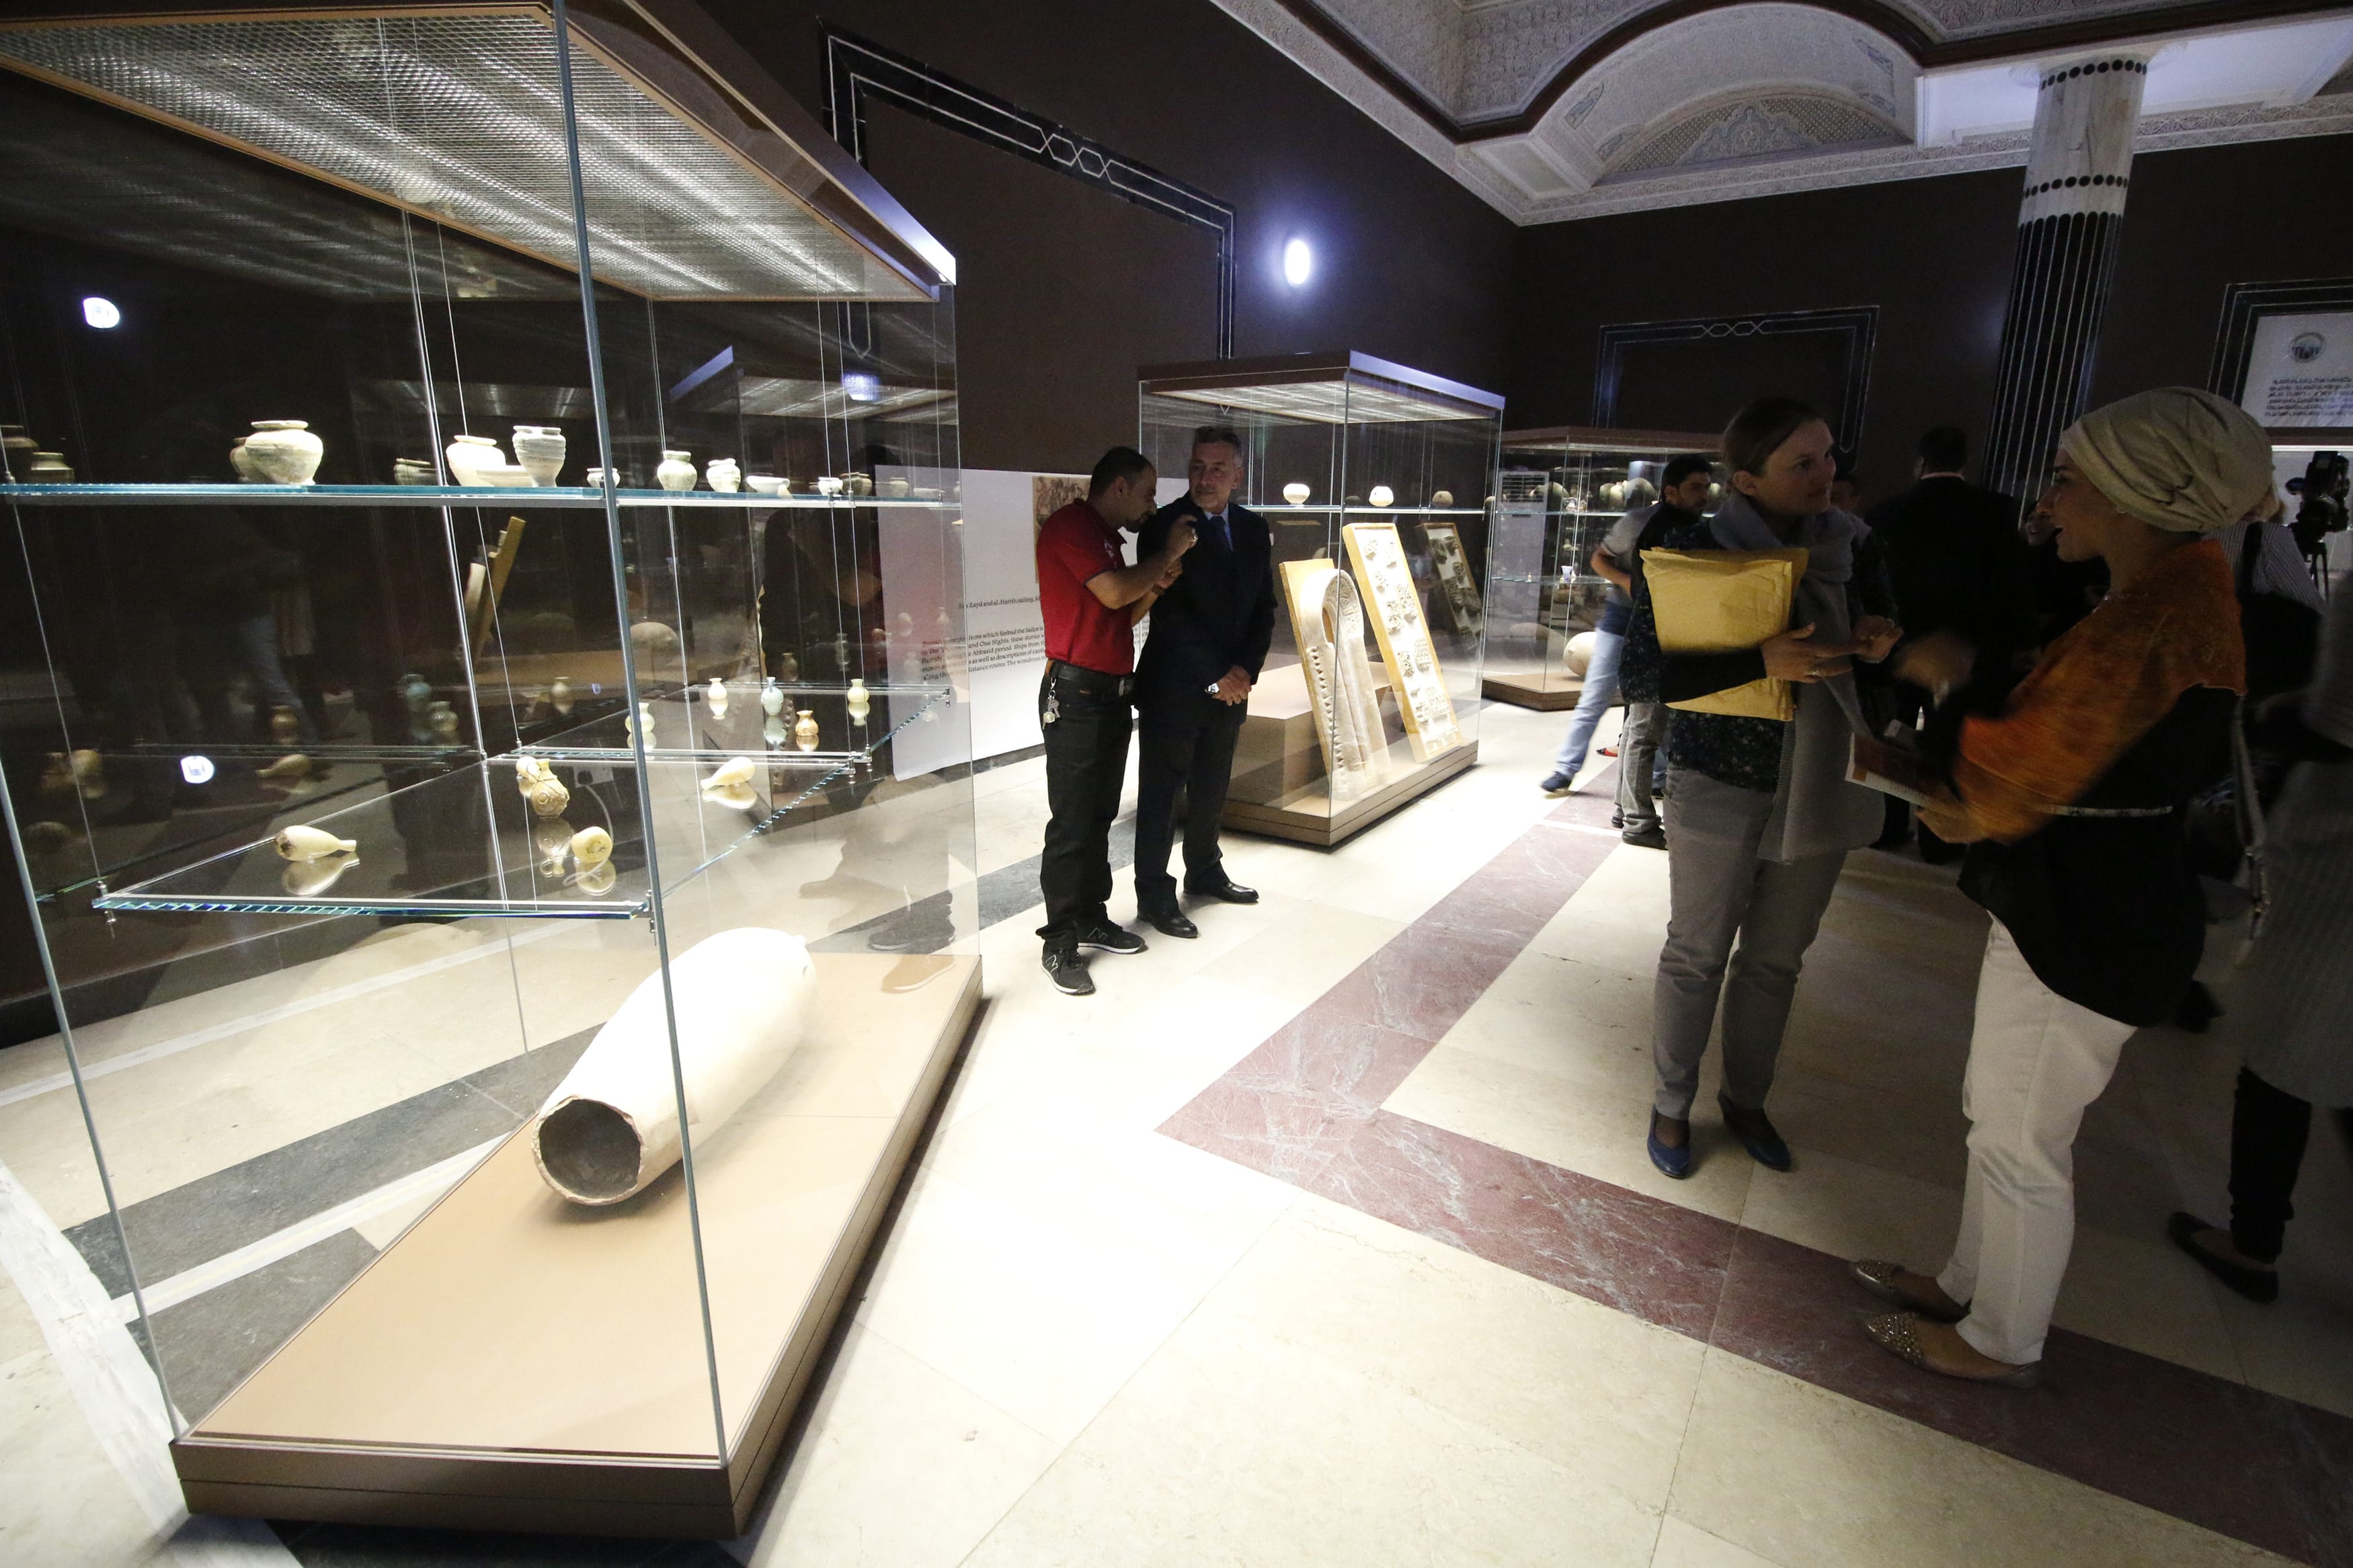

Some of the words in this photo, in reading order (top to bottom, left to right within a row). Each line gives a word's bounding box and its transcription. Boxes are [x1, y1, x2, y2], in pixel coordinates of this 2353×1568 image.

[973, 647, 994, 656] Abbasid
[995, 645, 1012, 653] period.
[1014, 643, 1027, 651] Ships
[978, 655, 990, 663] well
[996, 651, 1027, 660] descriptions
[989, 661, 1006, 669] routes.
[1017, 657, 1041, 665] wondrous
